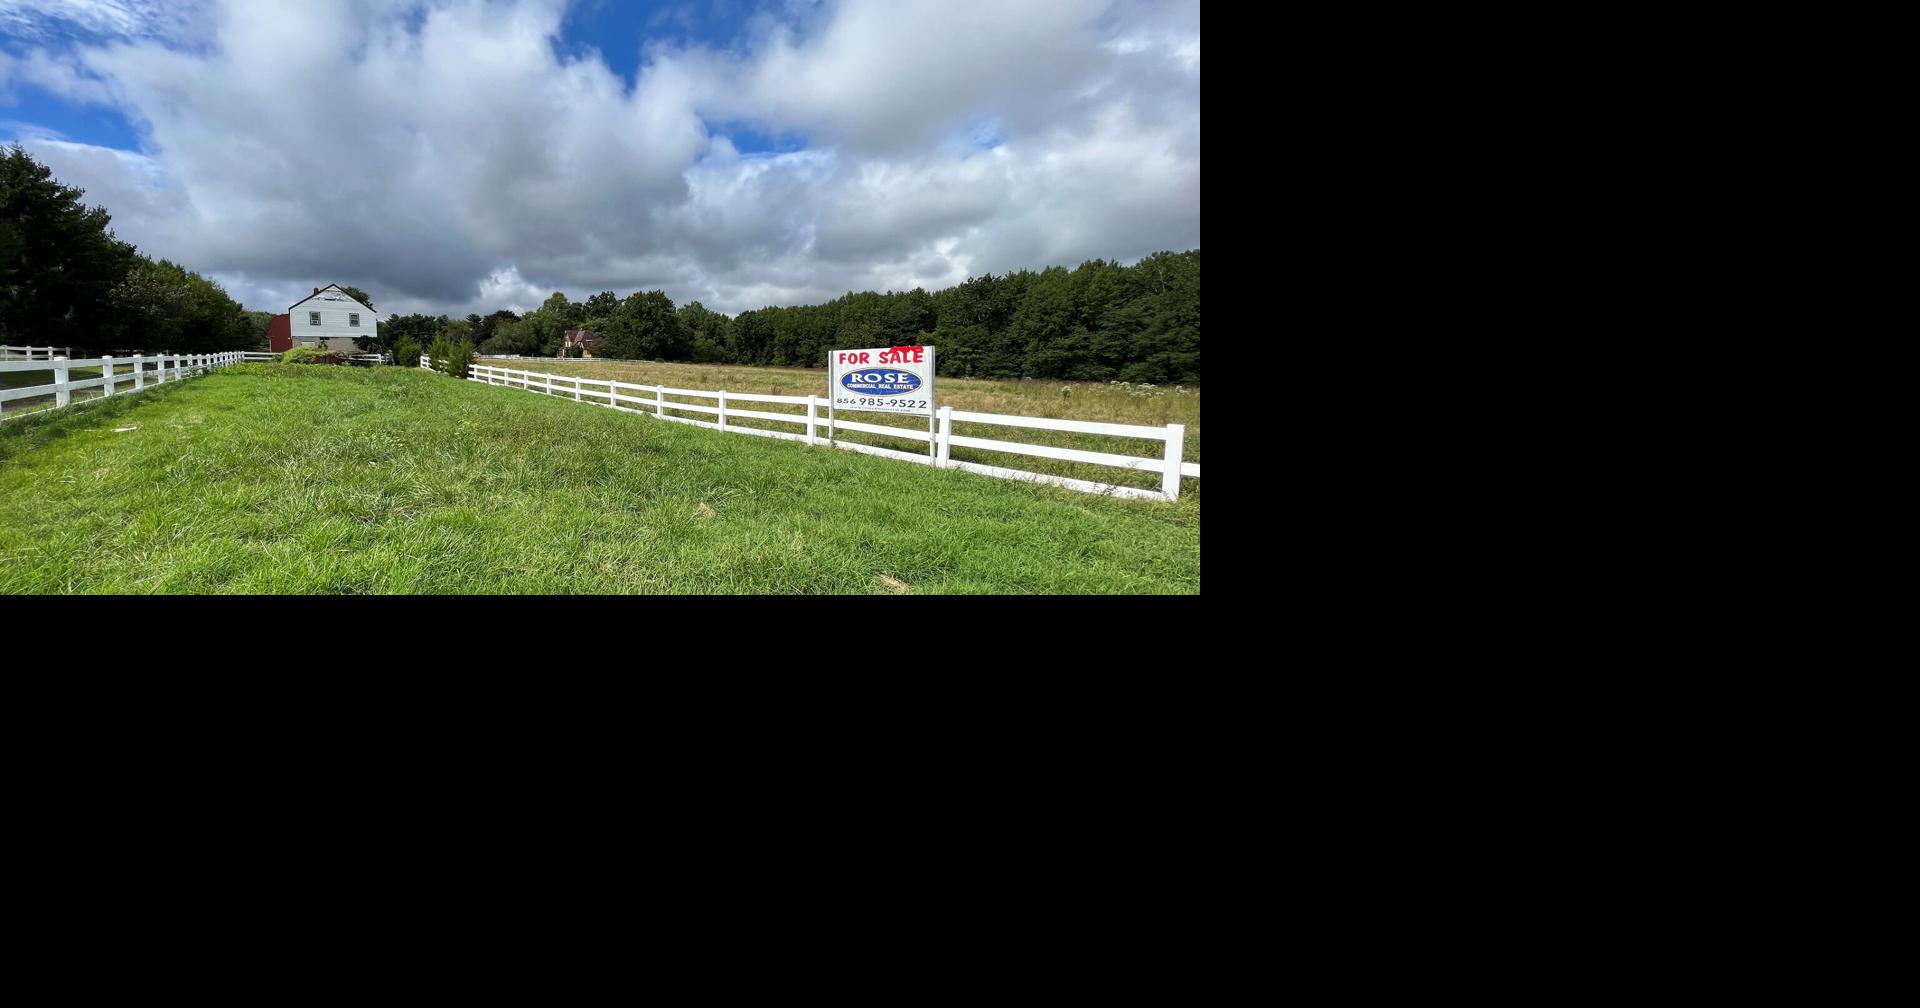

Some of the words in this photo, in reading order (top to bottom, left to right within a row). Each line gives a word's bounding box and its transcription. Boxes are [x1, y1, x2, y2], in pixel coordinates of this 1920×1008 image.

[839, 352, 869, 364] FOR
[879, 347, 924, 364] SALE
[851, 373, 909, 383] ROSE
[859, 397, 927, 409] 985-9522
